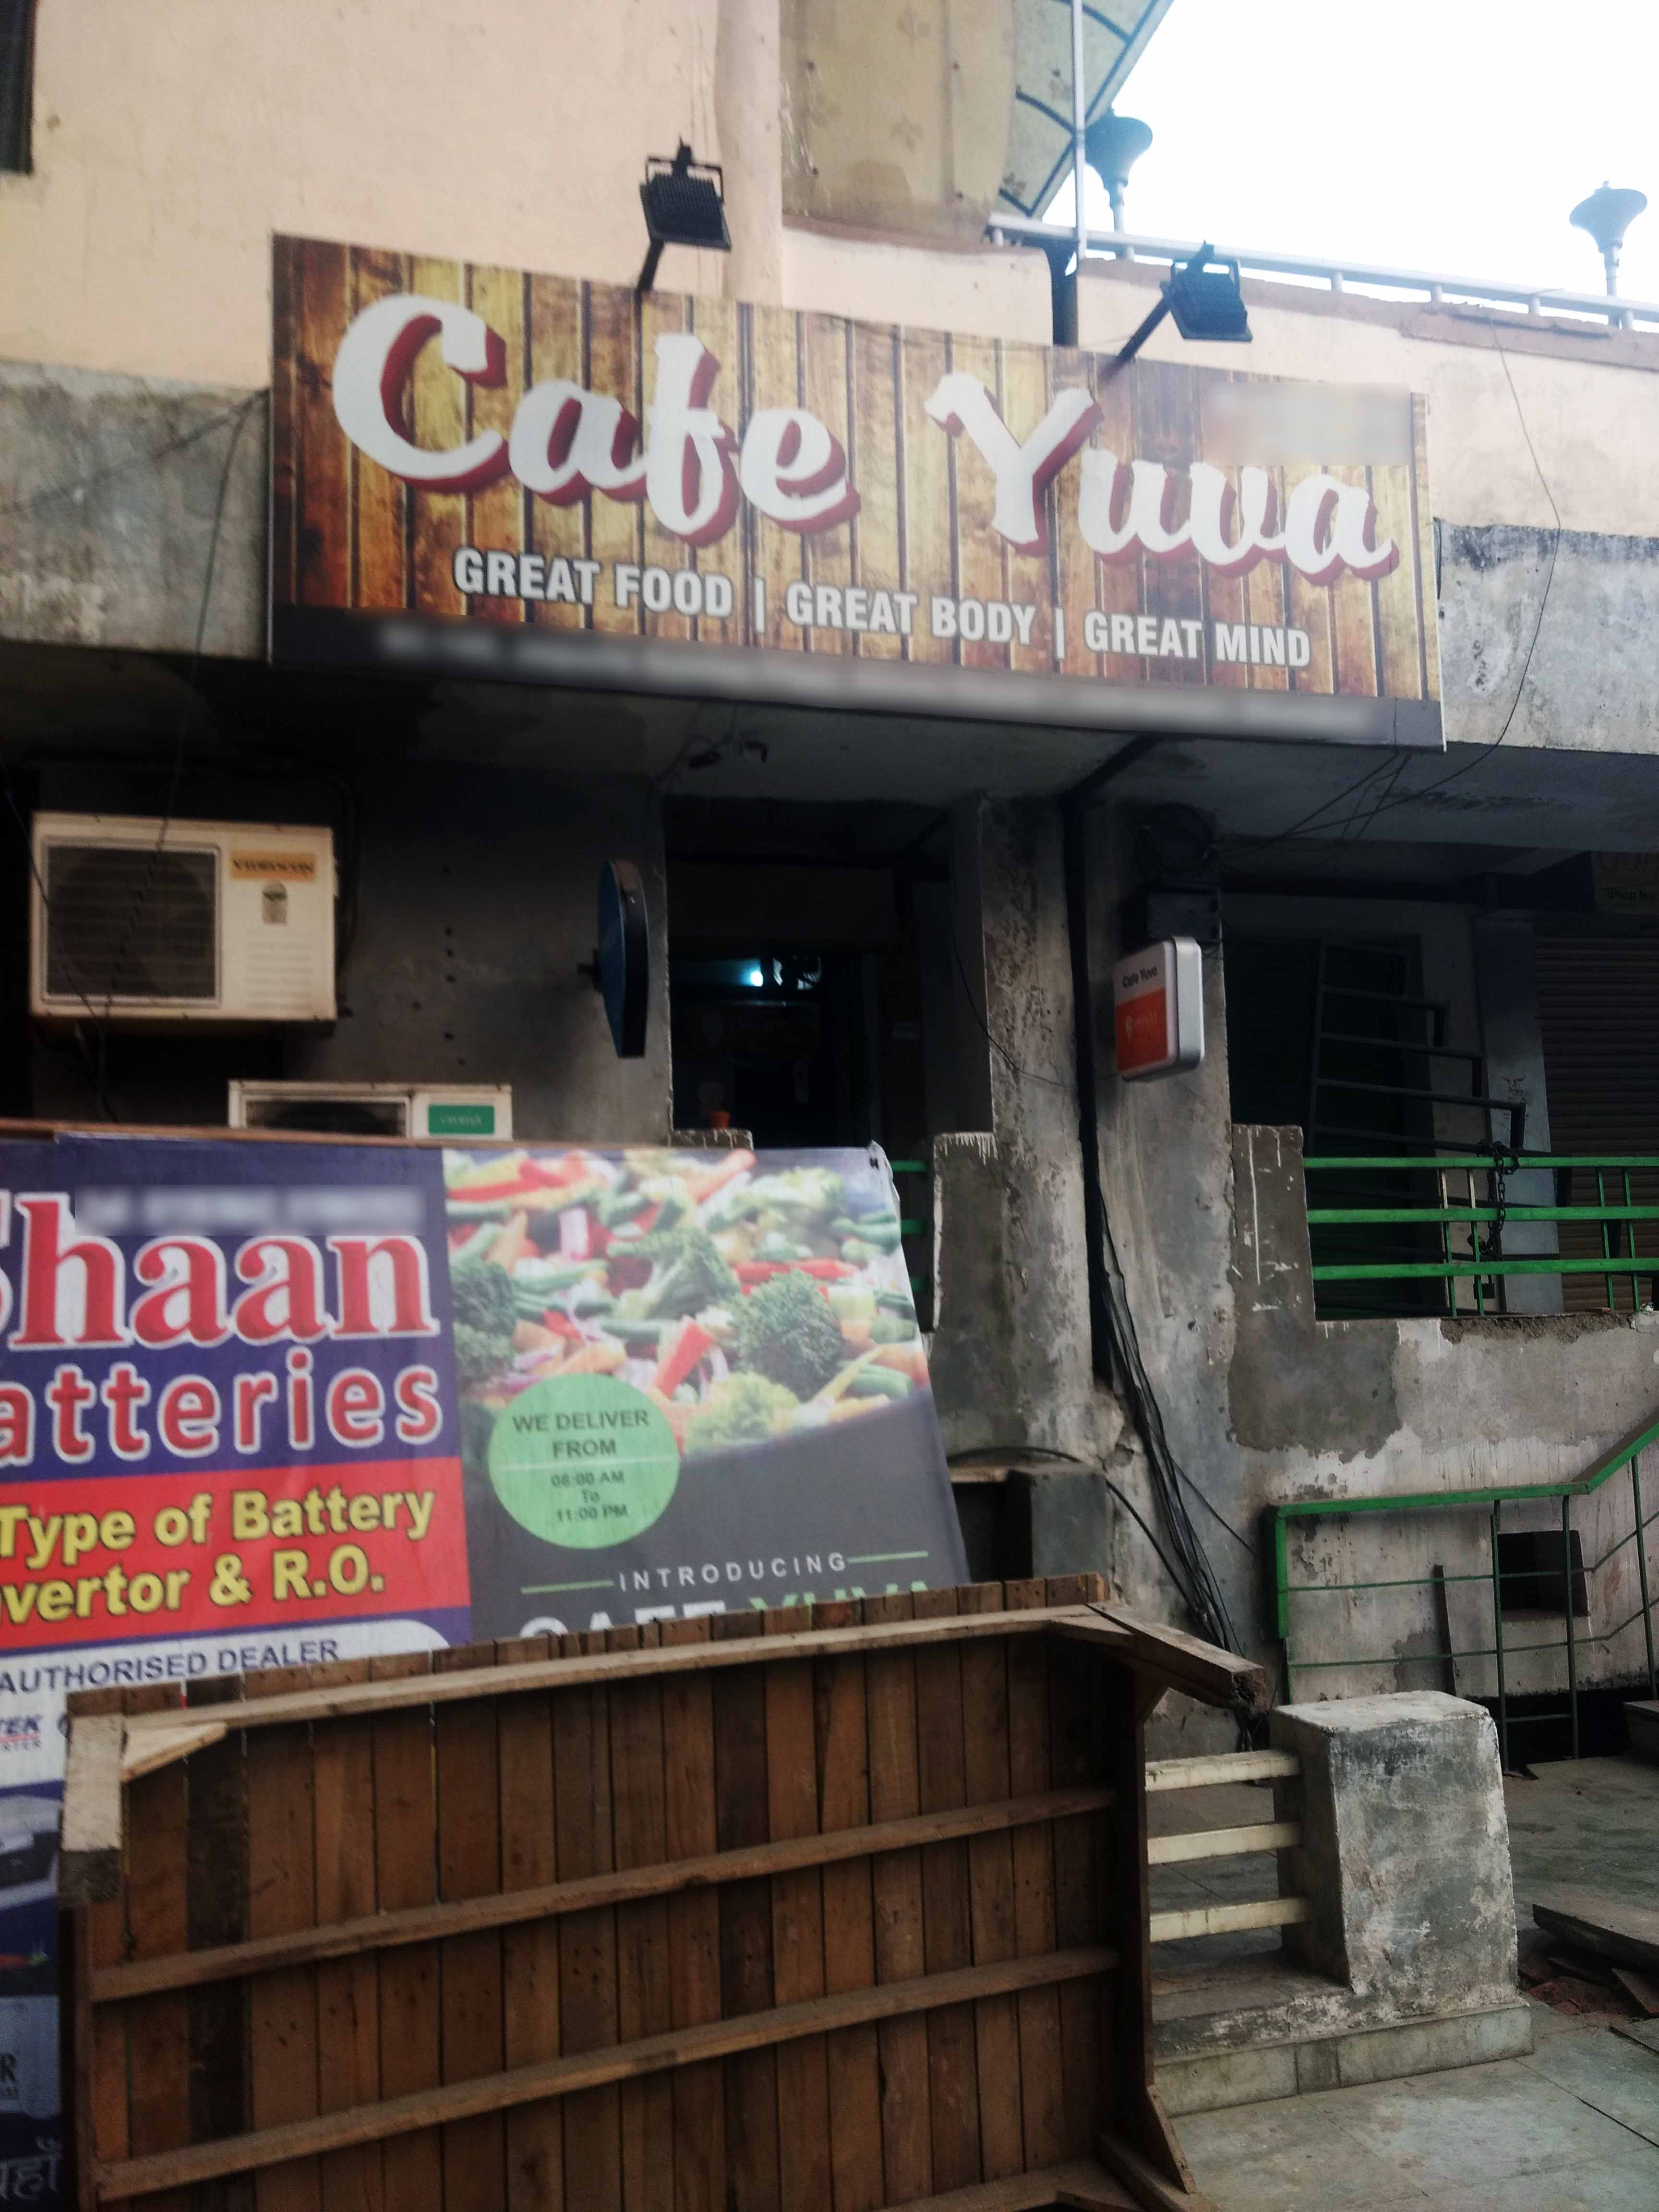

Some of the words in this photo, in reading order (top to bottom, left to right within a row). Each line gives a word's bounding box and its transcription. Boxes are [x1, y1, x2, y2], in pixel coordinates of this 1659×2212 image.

[333, 293, 861, 546] Cafe
[924, 371, 1399, 585] Yuva
[454, 546, 601, 605] GREAT
[615, 564, 733, 618] FOOD
[787, 581, 917, 633] GREAT
[931, 597, 1035, 645] BODY
[1084, 609, 1202, 660] GREAT
[1215, 623, 1310, 668] MIND
[0, 1190, 441, 1350] haan
[512, 1413, 550, 1433] WE
[555, 1408, 649, 1431] DELIVER
[552, 1438, 616, 1459] FROM
[599, 1469, 625, 1484] AM
[0, 1505, 135, 1569] Type
[154, 1492, 212, 1546] of
[231, 1485, 435, 1541] Battery
[602, 1504, 628, 1520] PM
[208, 1553, 253, 1607] &
[273, 1544, 385, 1601] R.O.
[619, 1551, 847, 1592] INTRODUCING
[0, 1651, 207, 1695] AUTHORISED
[218, 1638, 340, 1672] DEALER
